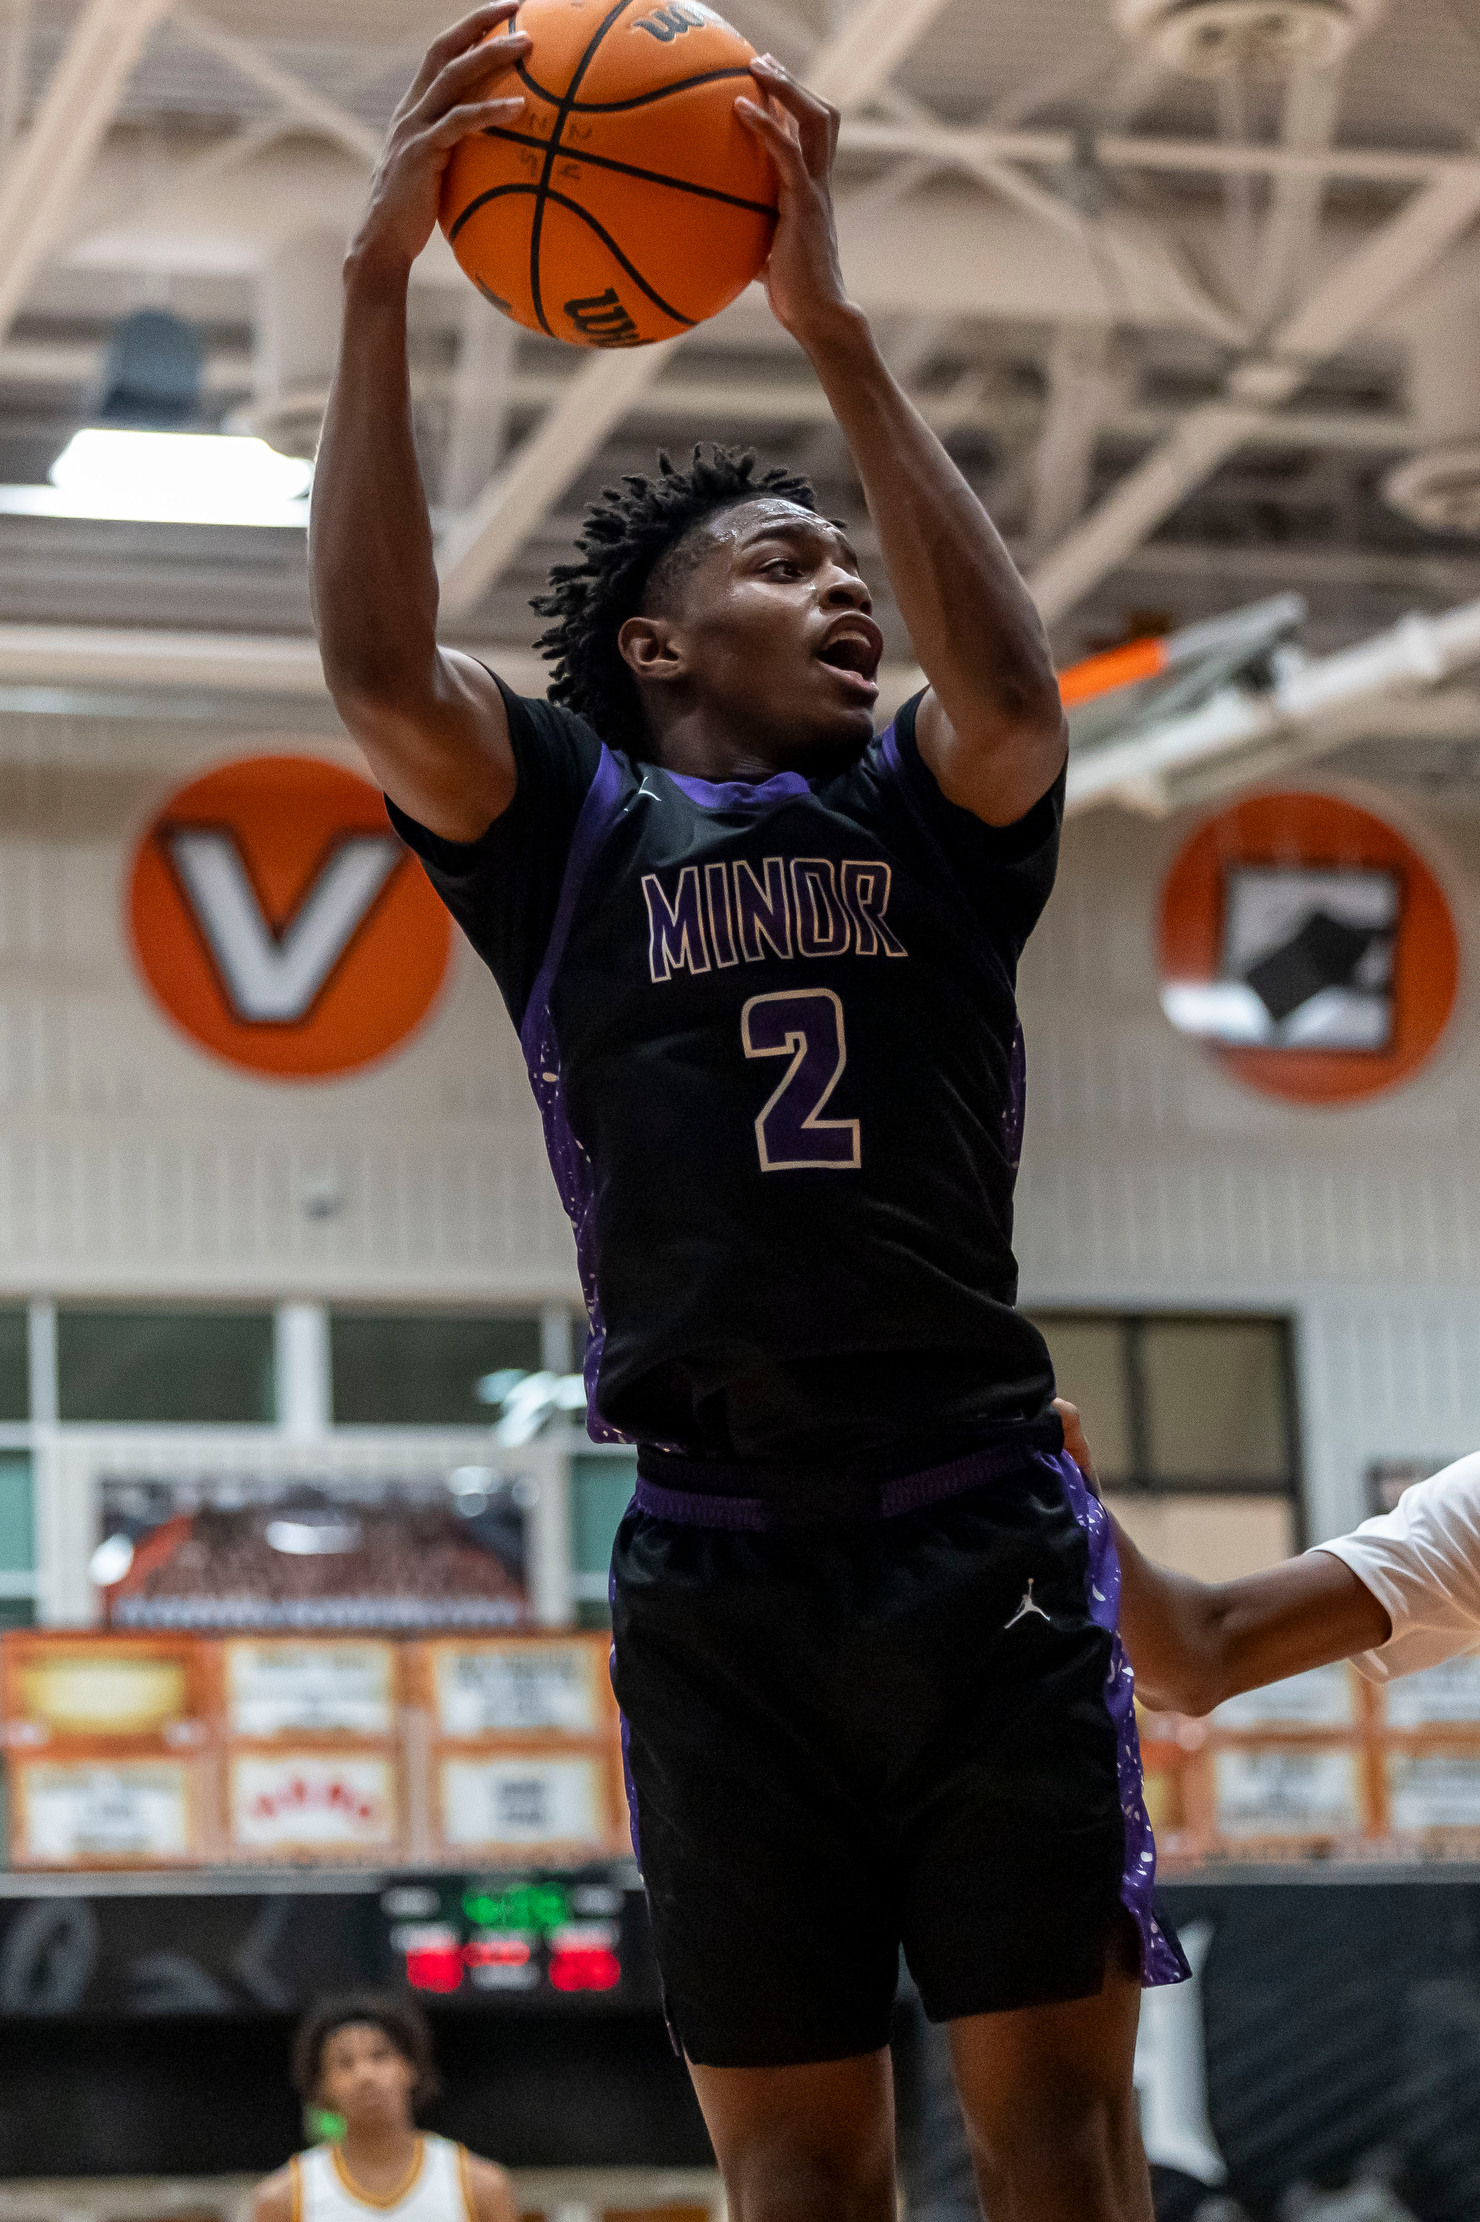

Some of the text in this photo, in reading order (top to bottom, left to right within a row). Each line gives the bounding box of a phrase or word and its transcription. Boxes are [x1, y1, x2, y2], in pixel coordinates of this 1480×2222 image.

[166, 825, 404, 1024] V
[641, 857, 908, 983] MINOR
[740, 987, 862, 1172] 2
